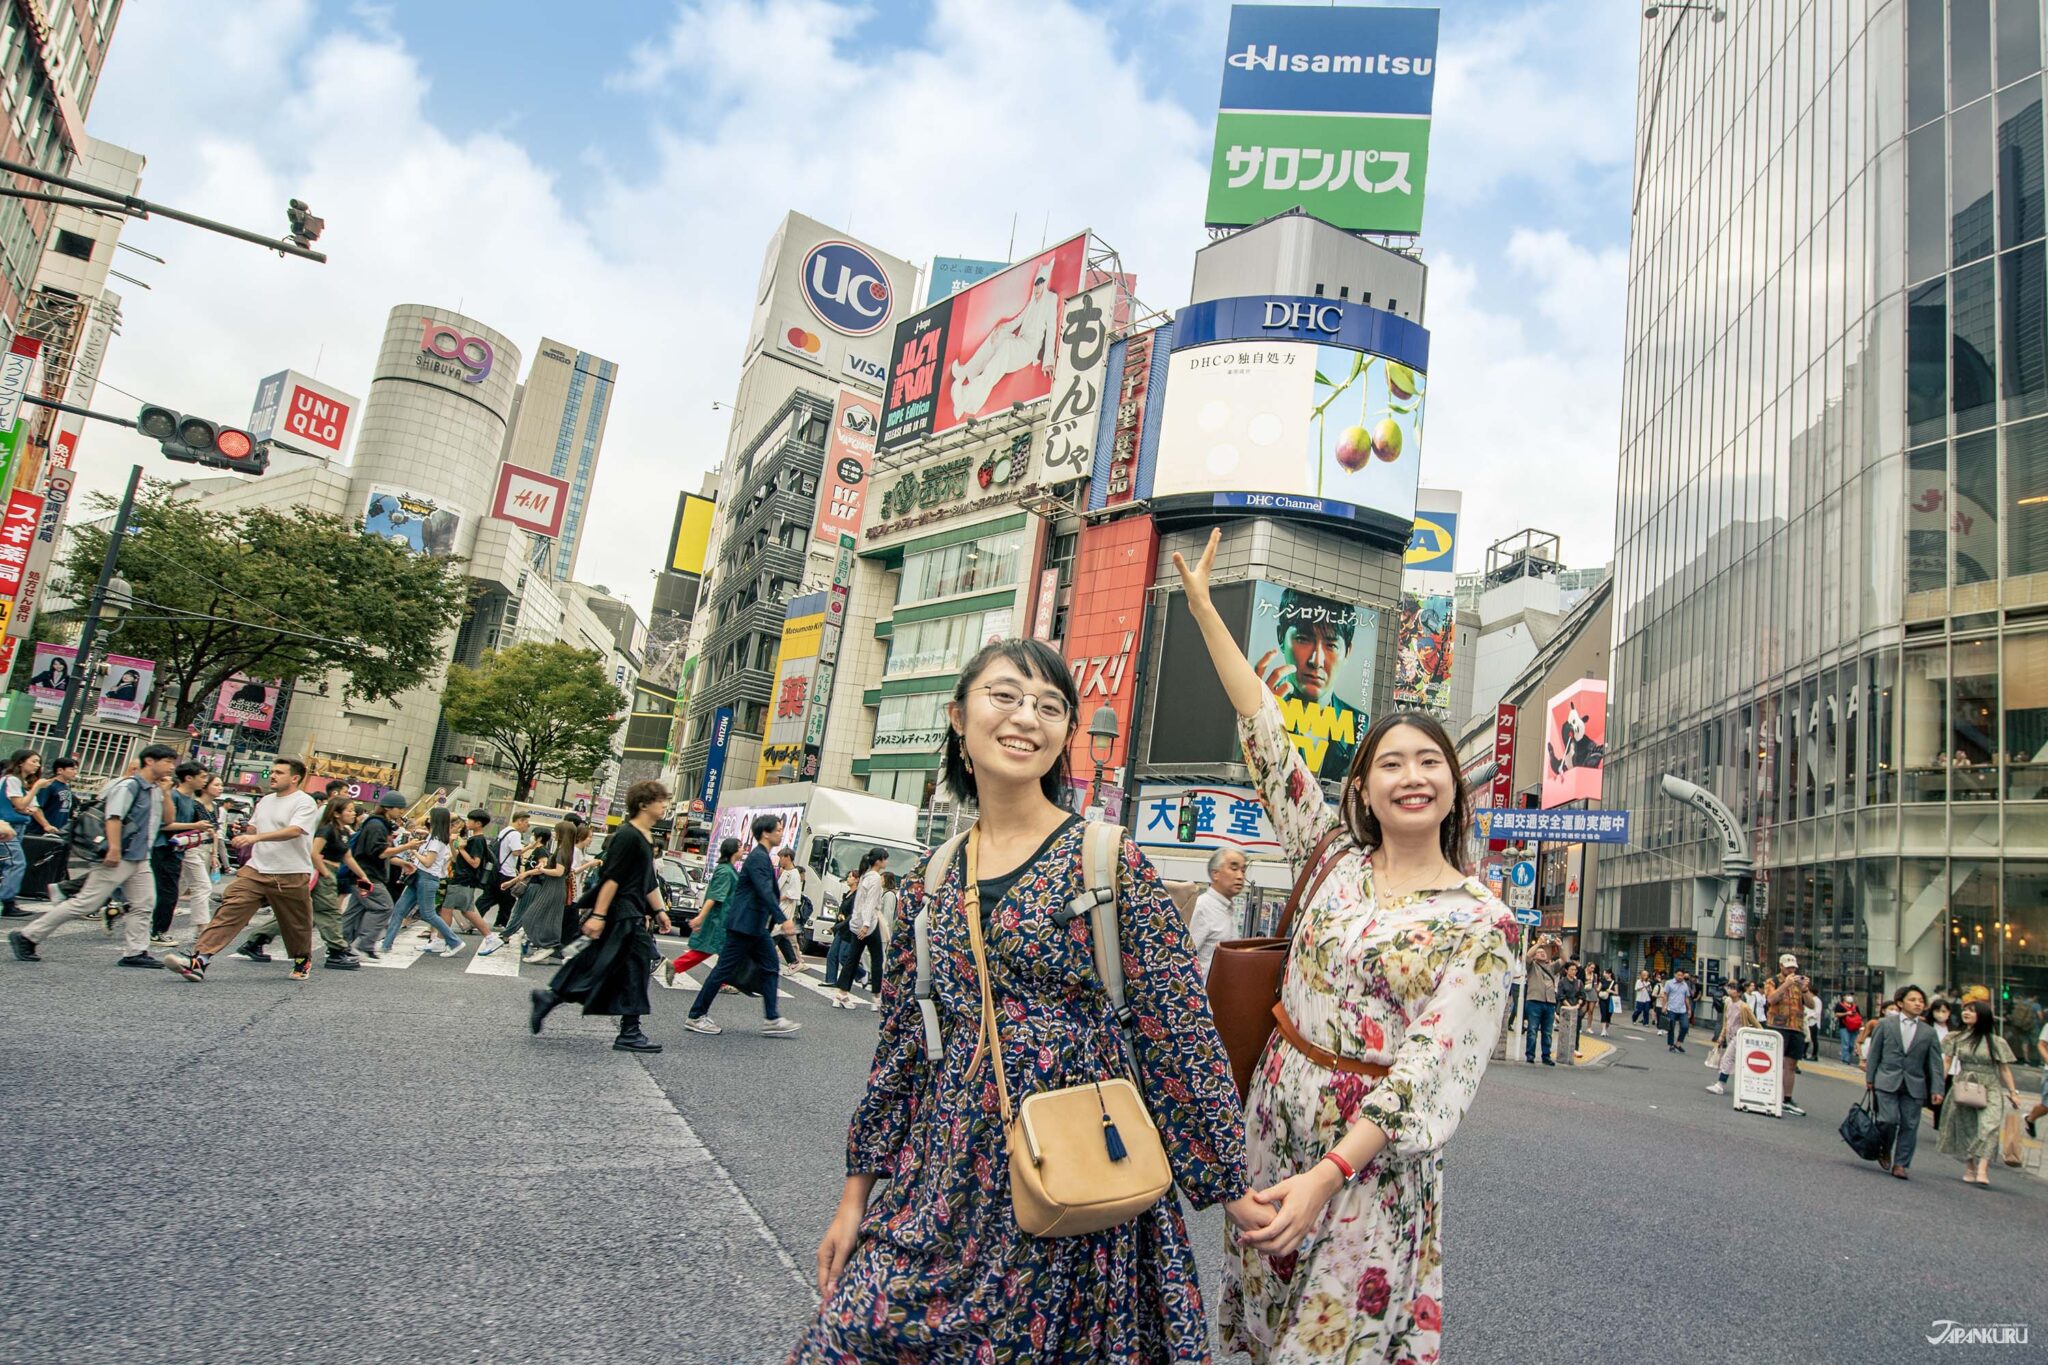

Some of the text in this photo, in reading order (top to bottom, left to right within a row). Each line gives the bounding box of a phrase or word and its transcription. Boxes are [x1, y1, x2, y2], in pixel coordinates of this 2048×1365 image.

[1228, 44, 1432, 76] Hisamitsu
[1226, 145, 1412, 195] サロンパス
[812, 254, 883, 317] UC
[1262, 302, 1344, 333] DHC
[421, 317, 495, 383] 109
[542, 350, 571, 365] INDIGO
[1190, 351, 1296, 370] DHCの独自処方
[416, 355, 463, 380] SHIBUYA
[848, 354, 886, 381] VISA
[1044, 294, 1103, 474] もんじゃ
[298, 393, 338, 424] UNI
[1107, 335, 1148, 495] 三千里薬品
[293, 413, 338, 443] QLO
[514, 488, 550, 513] H&M
[1246, 494, 1322, 511] DHC Channel
[0, 503, 37, 583] スギ薬局
[16, 571, 40, 623] 処方せん受付
[1257, 597, 1377, 629] ケンシロウによろしく
[785, 624, 814, 635] Matsumoto
[778, 675, 807, 718] 薬
[717, 715, 729, 747] MIZUHO
[1495, 714, 1514, 785] カラオケ
[1493, 813, 1625, 832] 全国交通安全運動実施中
